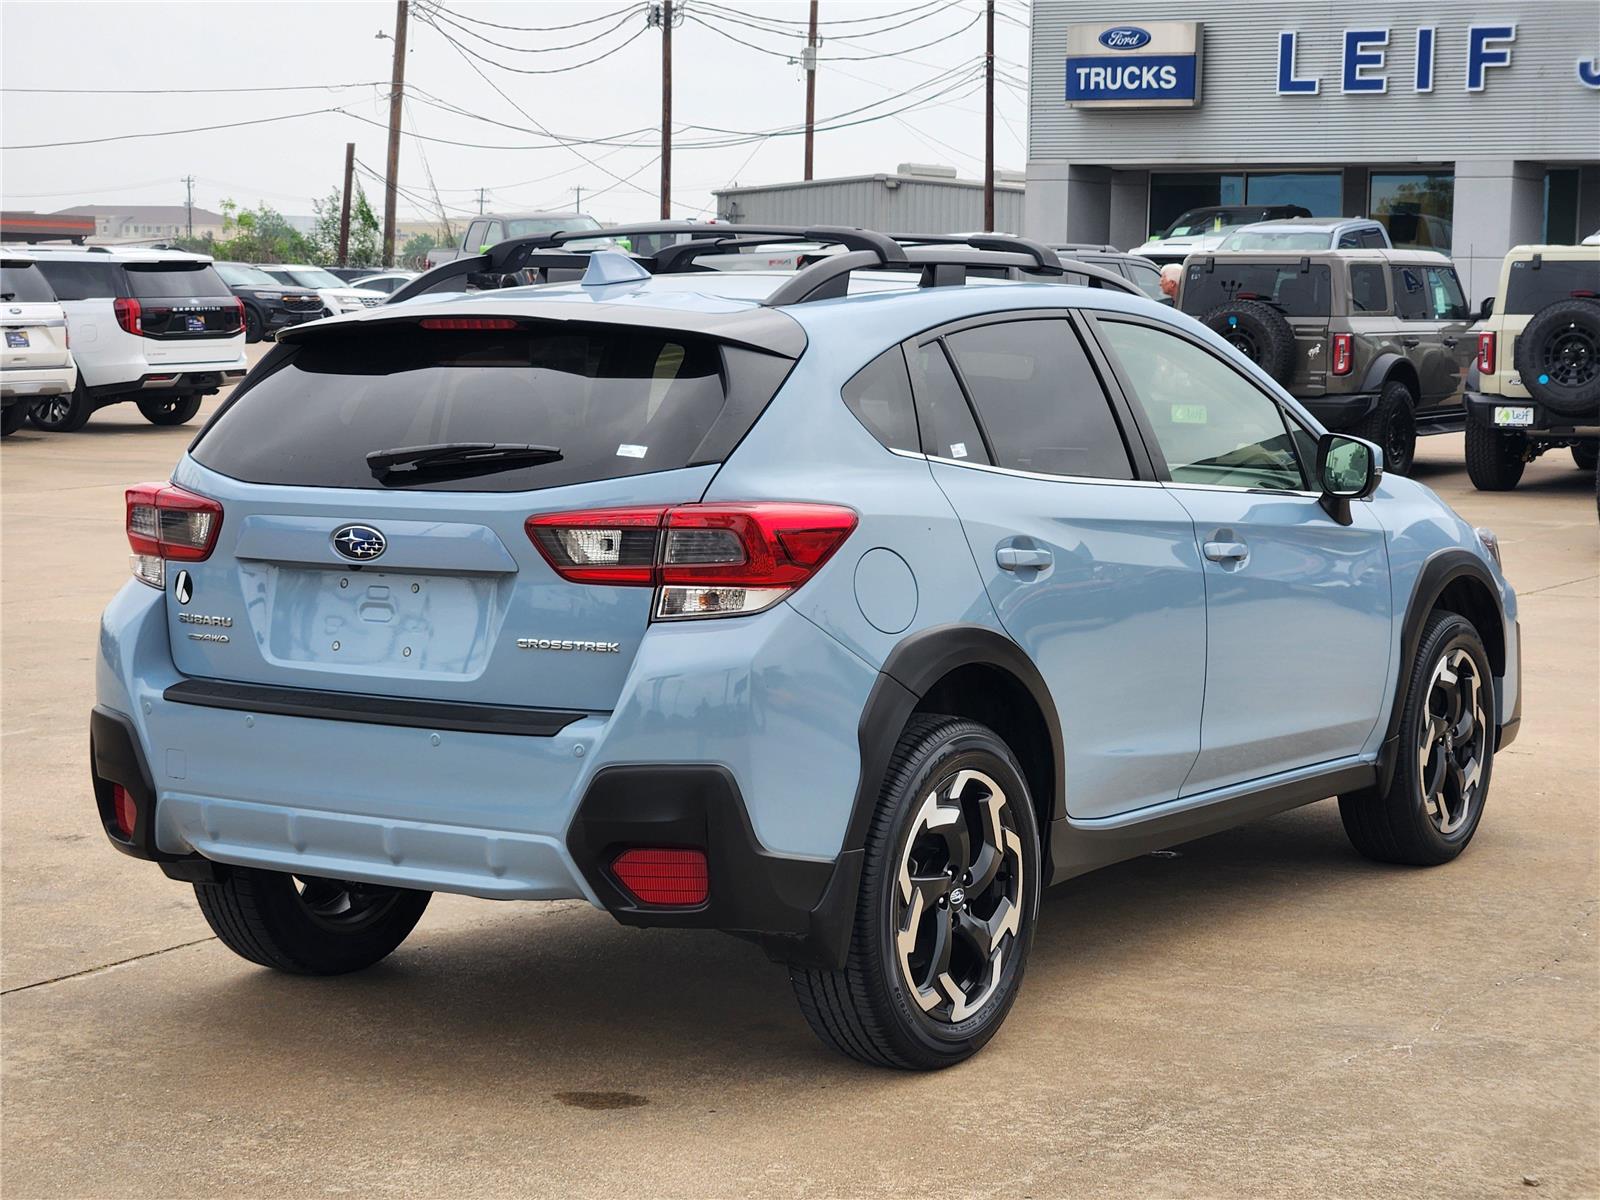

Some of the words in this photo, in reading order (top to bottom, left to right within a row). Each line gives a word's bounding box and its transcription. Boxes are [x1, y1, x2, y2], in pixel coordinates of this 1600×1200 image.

[1107, 30, 1140, 46] Ford
[1276, 23, 1517, 96] LEIF
[1076, 65, 1177, 90] TRUCKS
[178, 612, 232, 627] SUBARU
[516, 638, 620, 653] CROSSTREK
